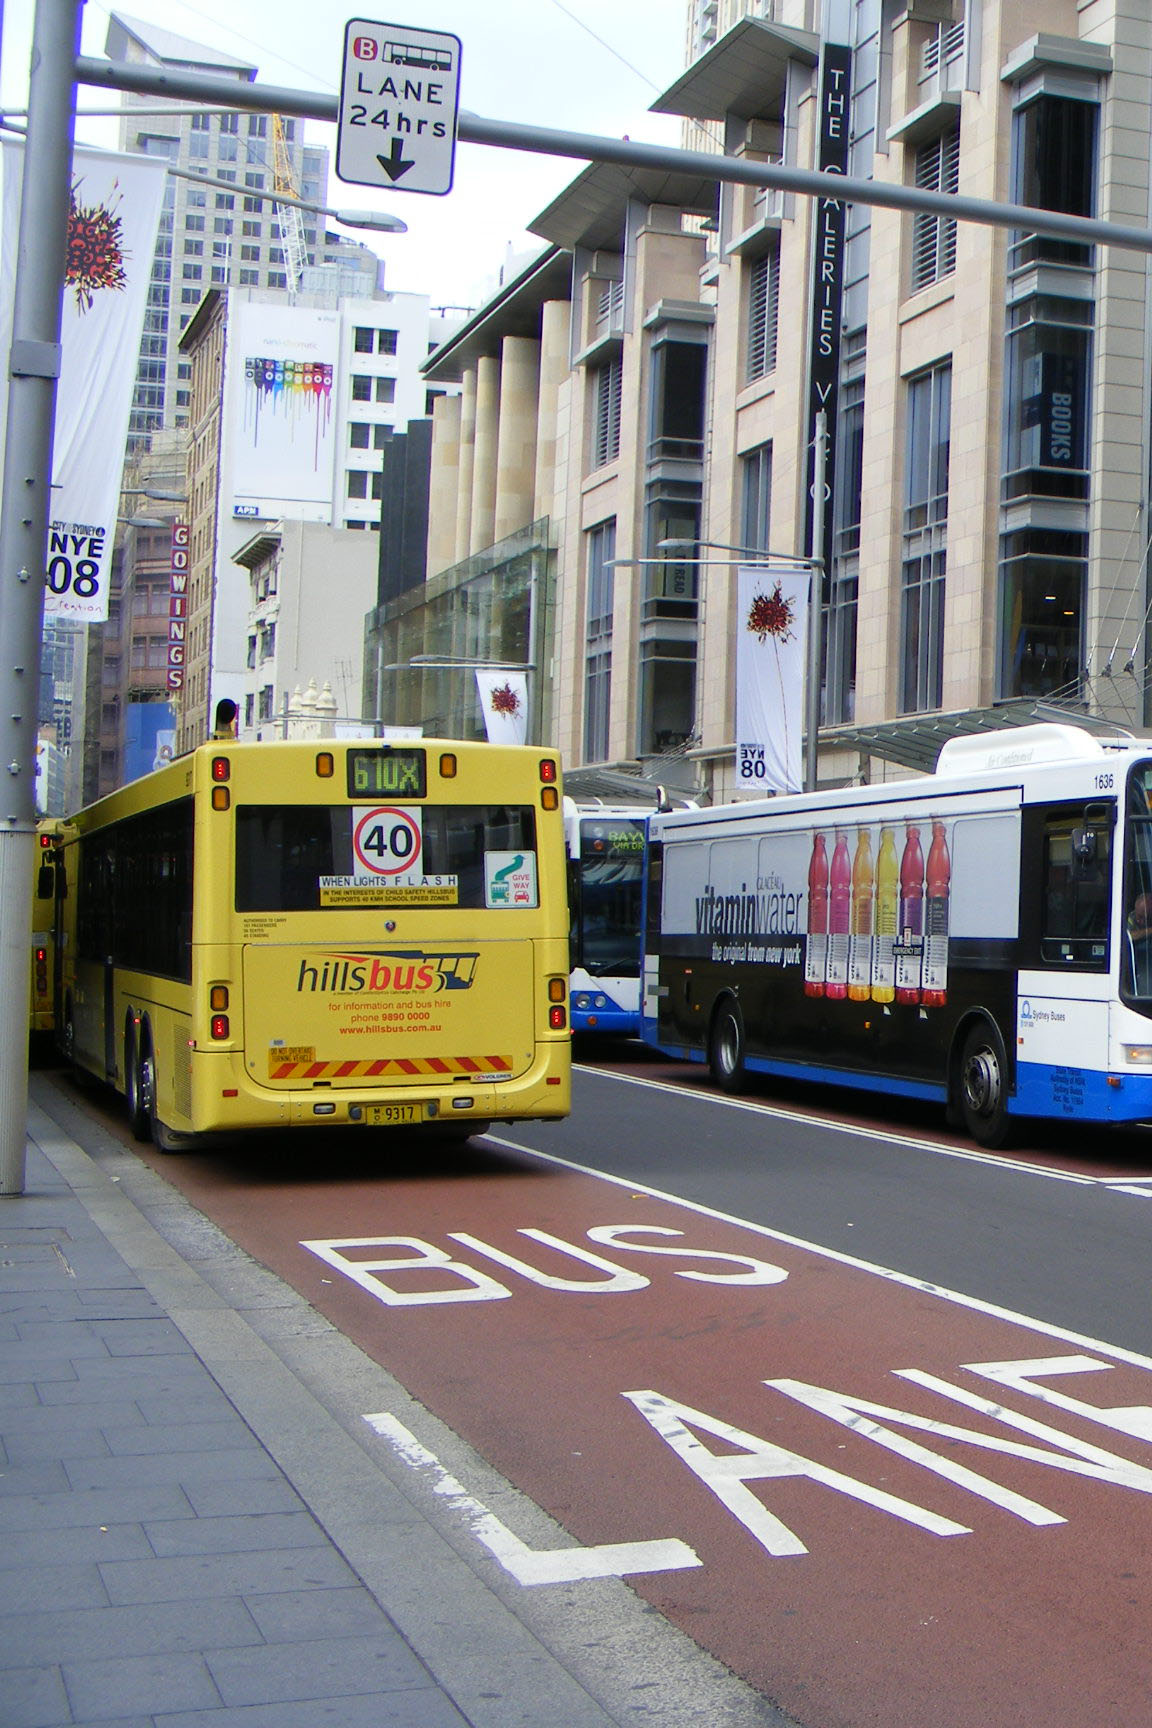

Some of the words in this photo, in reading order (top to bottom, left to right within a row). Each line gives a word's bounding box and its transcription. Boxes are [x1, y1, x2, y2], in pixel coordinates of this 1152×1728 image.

[357, 72, 443, 105] LANE
[827, 68, 845, 138] THE
[350, 105, 446, 138] 24hrs
[1050, 392, 1072, 460] BOOKS
[50, 532, 104, 558] NYE
[48, 556, 100, 598] 08
[674, 568, 686, 594] READ
[168, 527, 188, 689] GOWINGS
[354, 756, 419, 790] 610X
[1094, 773, 1114, 789] 1636
[363, 825, 413, 857] 40
[322, 877, 351, 887] WHEN
[354, 876, 387, 887] LIGHTS
[695, 882, 803, 934] vitaminwater
[712, 941, 722, 961] the
[723, 941, 747, 965] original
[747, 941, 765, 962] from
[765, 946, 782, 963] new
[782, 943, 801, 968] york
[297, 959, 434, 991] hillsbus
[328, 1002, 341, 1011] for
[343, 1001, 394, 1011] information
[396, 1000, 413, 1010] and
[415, 1000, 432, 1009] bus
[434, 999, 452, 1008] hire
[350, 1013, 380, 1024] phone
[381, 1012, 404, 1022] 9890
[407, 1012, 430, 1021] 0000
[1032, 1009, 1050, 1022] Sydney
[1050, 1011, 1066, 1022] Buses
[339, 1024, 442, 1035] www.hillsbus.com.au
[385, 1106, 414, 1121] 9317
[298, 1224, 790, 1307] BUS
